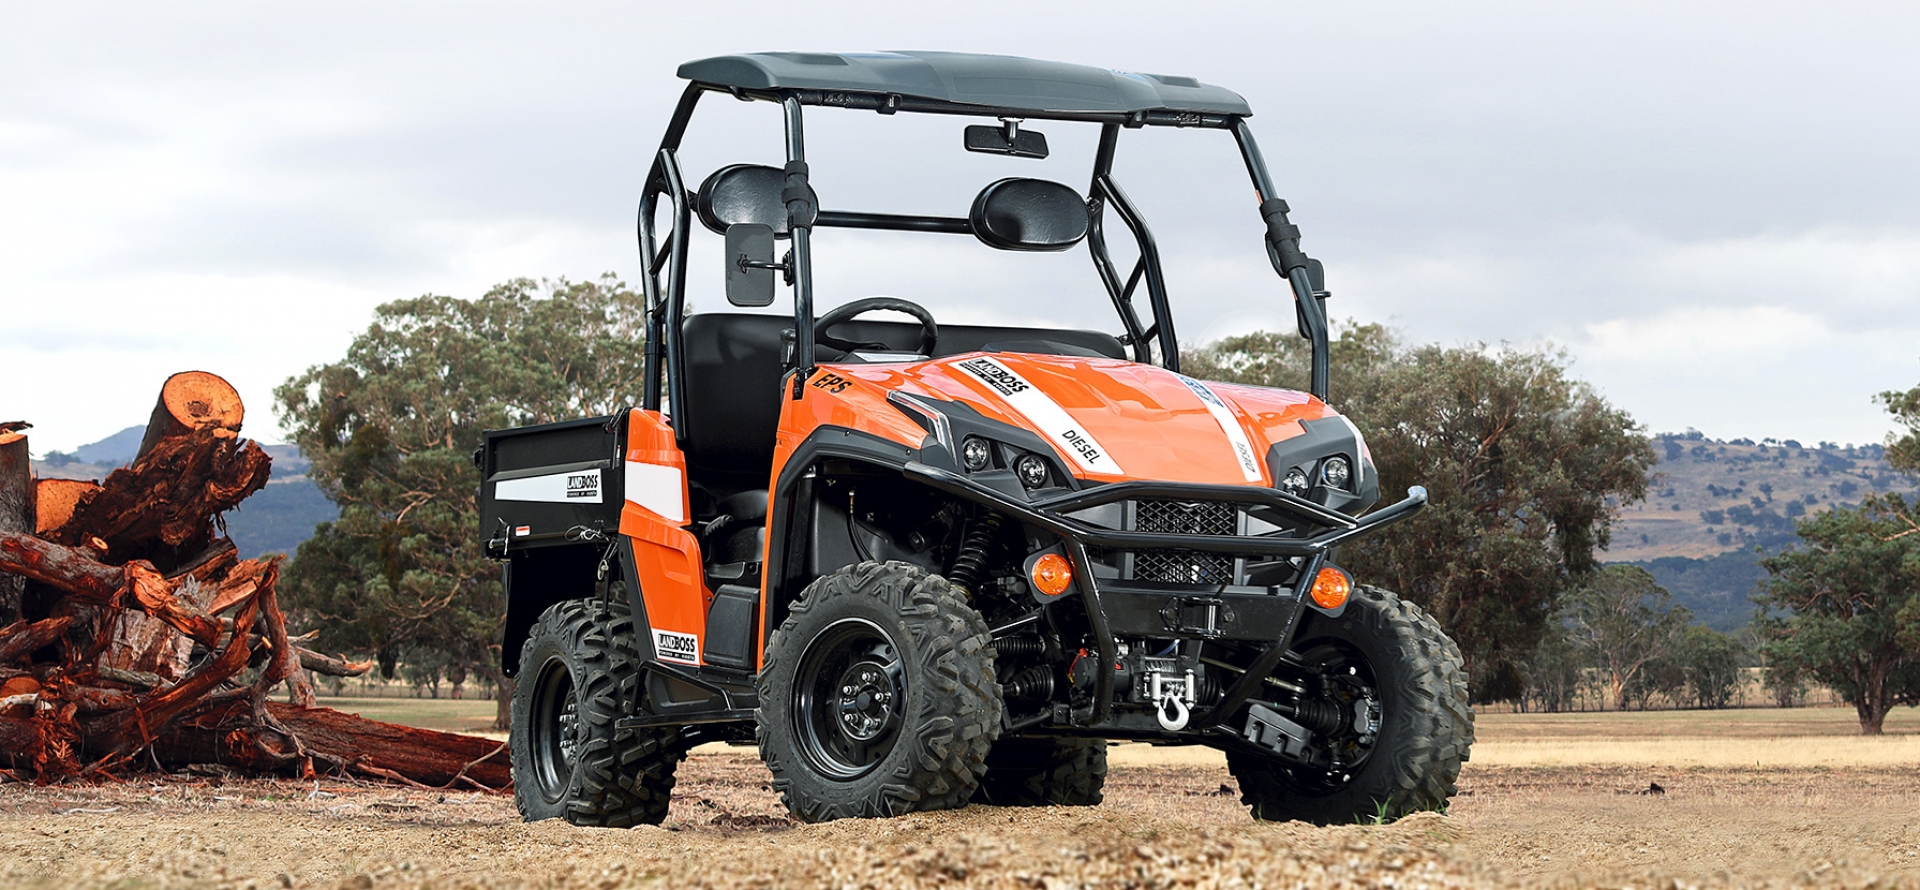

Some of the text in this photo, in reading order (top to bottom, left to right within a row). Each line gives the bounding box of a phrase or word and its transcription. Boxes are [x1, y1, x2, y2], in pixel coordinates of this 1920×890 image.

[812, 373, 852, 393] EPS
[967, 358, 1030, 392] LANDBOSS
[1062, 429, 1100, 464] DIESEL
[567, 475, 598, 490] LANDBOSS
[659, 633, 696, 652] LANDBOSS
